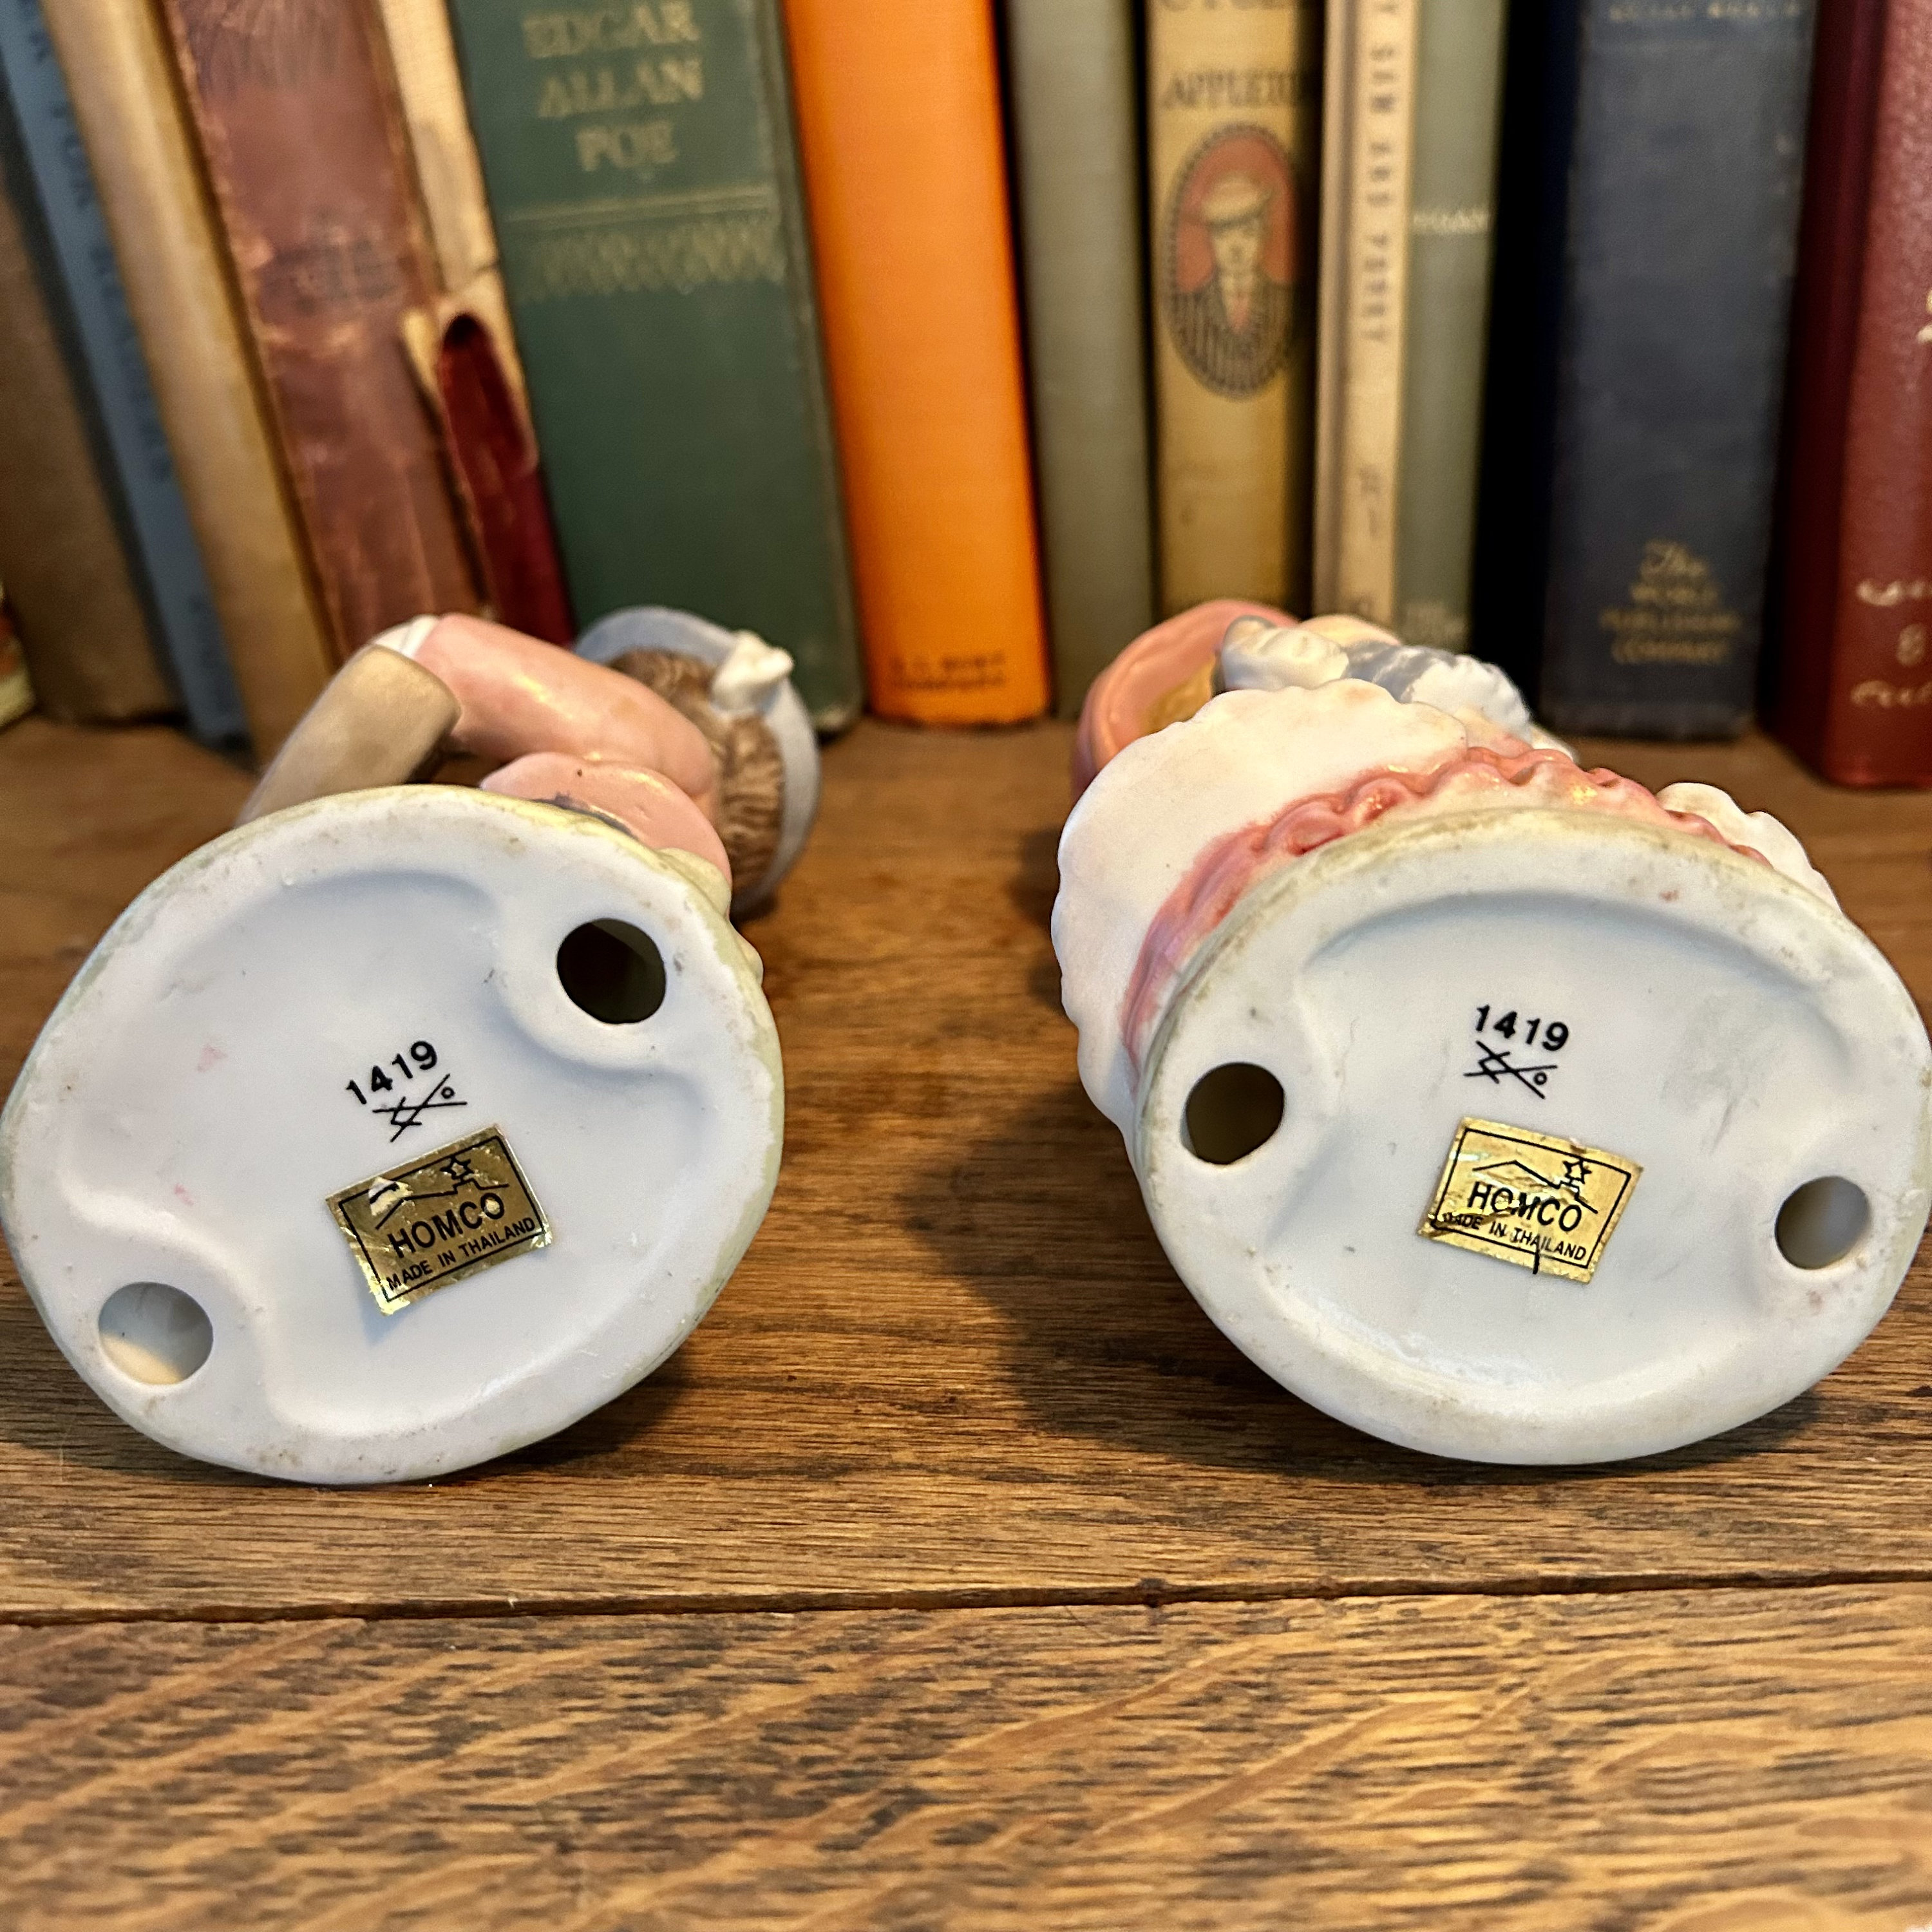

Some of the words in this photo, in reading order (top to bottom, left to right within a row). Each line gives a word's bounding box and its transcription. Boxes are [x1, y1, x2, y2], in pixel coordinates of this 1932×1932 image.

[522, 1, 702, 59] EDGAR
[537, 58, 703, 118] ALLAN
[576, 120, 677, 172] POE
[1475, 1004, 1569, 1052] 1419
[346, 1040, 438, 1104] 1419
[387, 1192, 505, 1259] HOMCO
[1466, 1181, 1582, 1232] HOMCO
[387, 1260, 433, 1291] MADE
[438, 1251, 457, 1268] IN
[458, 1216, 536, 1255] THAILAND
[1488, 1220, 1507, 1237] IN
[1513, 1227, 1587, 1260] THAILAND
